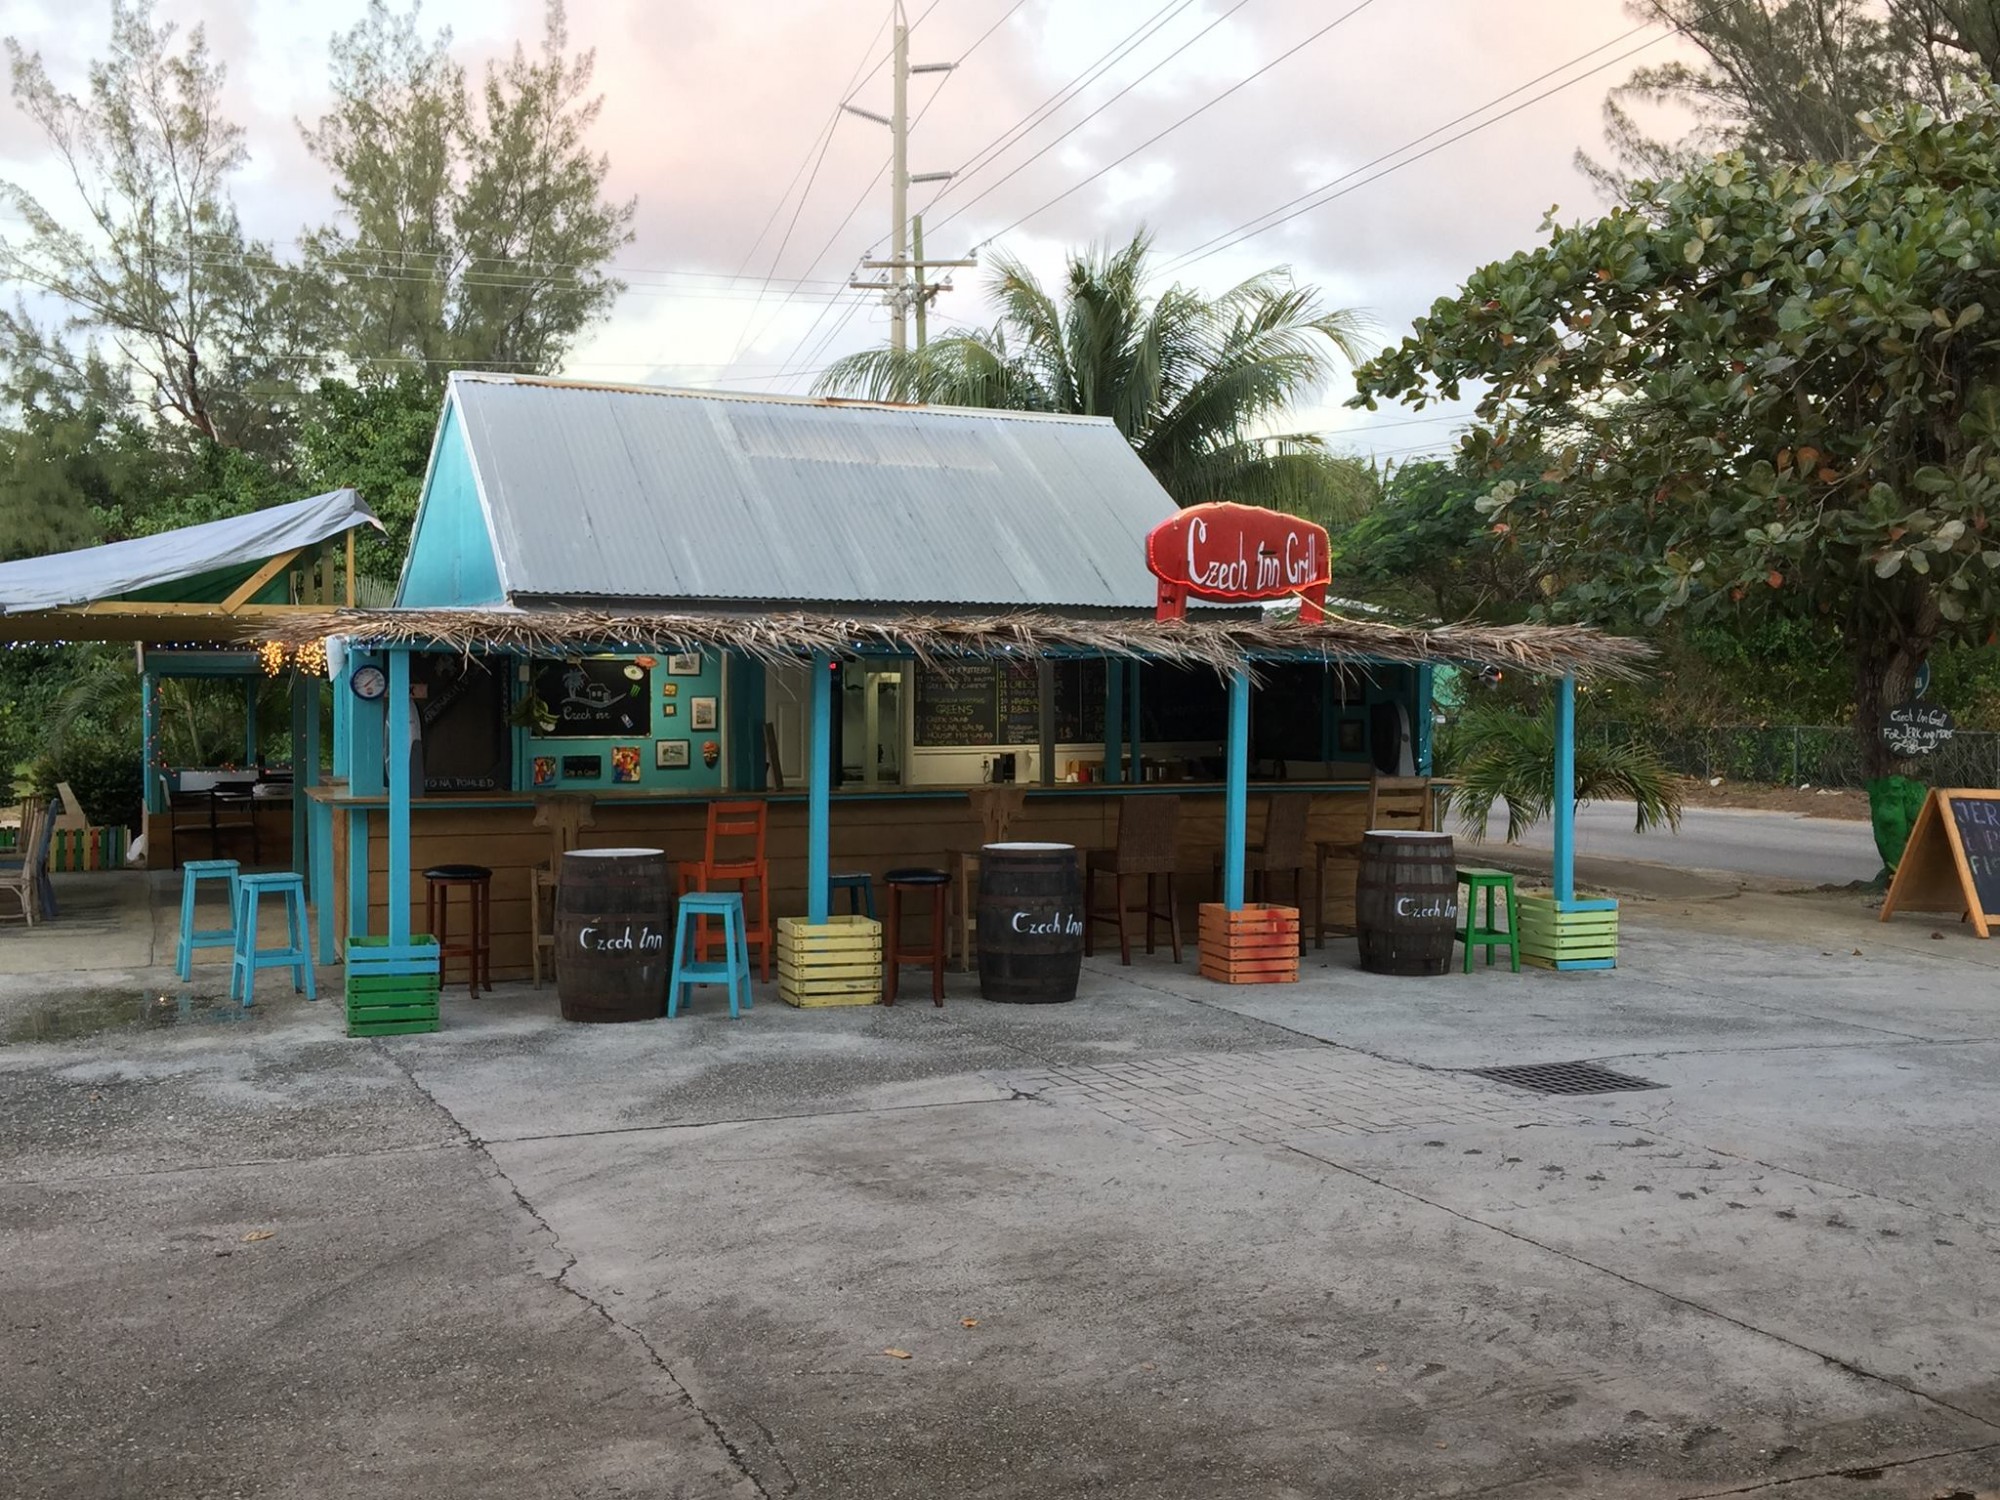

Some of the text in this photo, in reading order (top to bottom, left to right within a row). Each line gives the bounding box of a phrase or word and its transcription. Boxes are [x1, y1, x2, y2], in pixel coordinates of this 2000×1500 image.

[1187, 516, 1318, 591] Czech Inn Grill
[563, 706, 592, 720] Czech
[1901, 723, 1921, 739] JERK
[1397, 897, 1440, 918] Czech
[1012, 911, 1083, 936] Czech Inn
[579, 926, 663, 950] Czech Inn
